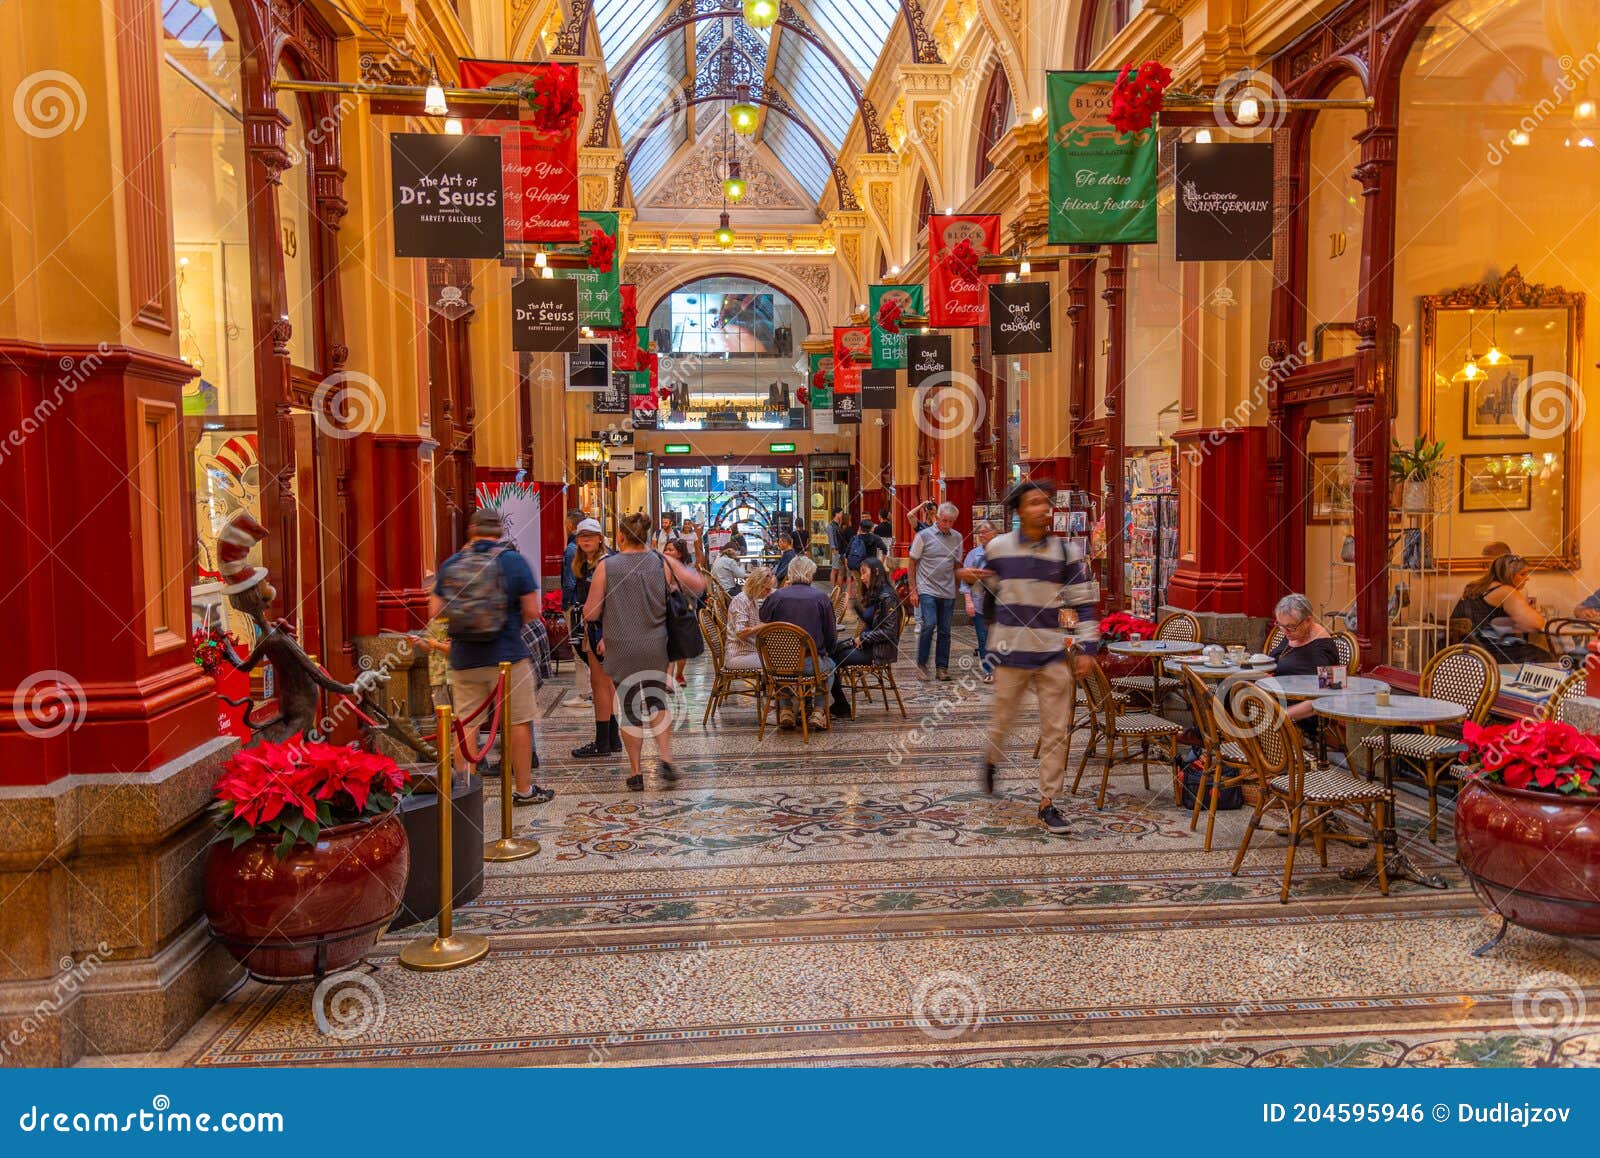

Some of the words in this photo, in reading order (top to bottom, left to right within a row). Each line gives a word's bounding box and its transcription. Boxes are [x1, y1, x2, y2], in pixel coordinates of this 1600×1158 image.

[536, 162, 562, 179] You
[1075, 169, 1097, 187] Te
[1098, 172, 1131, 185] deseo
[419, 175, 438, 187] The
[440, 173, 462, 186] Art
[466, 177, 478, 187] of
[399, 186, 431, 205] Dr.
[438, 187, 497, 207] Seuss
[526, 186, 570, 205] Happy
[1058, 197, 1100, 215] felices
[1099, 196, 1145, 215] fiestas
[1191, 199, 1269, 215] SAINT-GERMAIN
[420, 215, 445, 223] HARVEY
[448, 215, 482, 224] GALLERIES
[525, 214, 570, 229] Season
[283, 226, 297, 258] 19
[947, 231, 983, 240] BLOCK
[1328, 231, 1347, 259] 10
[950, 278, 982, 293] Boas
[528, 302, 539, 311] The
[540, 301, 553, 310] Art
[556, 302, 563, 310] of
[944, 299, 985, 314] Festas
[1008, 302, 1030, 314] Card
[515, 309, 535, 321] Dr.
[539, 310, 574, 321] Seuss
[1000, 320, 1041, 333] Caboodle
[921, 350, 938, 358] Card
[914, 363, 944, 372] Caboodle
[683, 478, 705, 488] MUSIC
